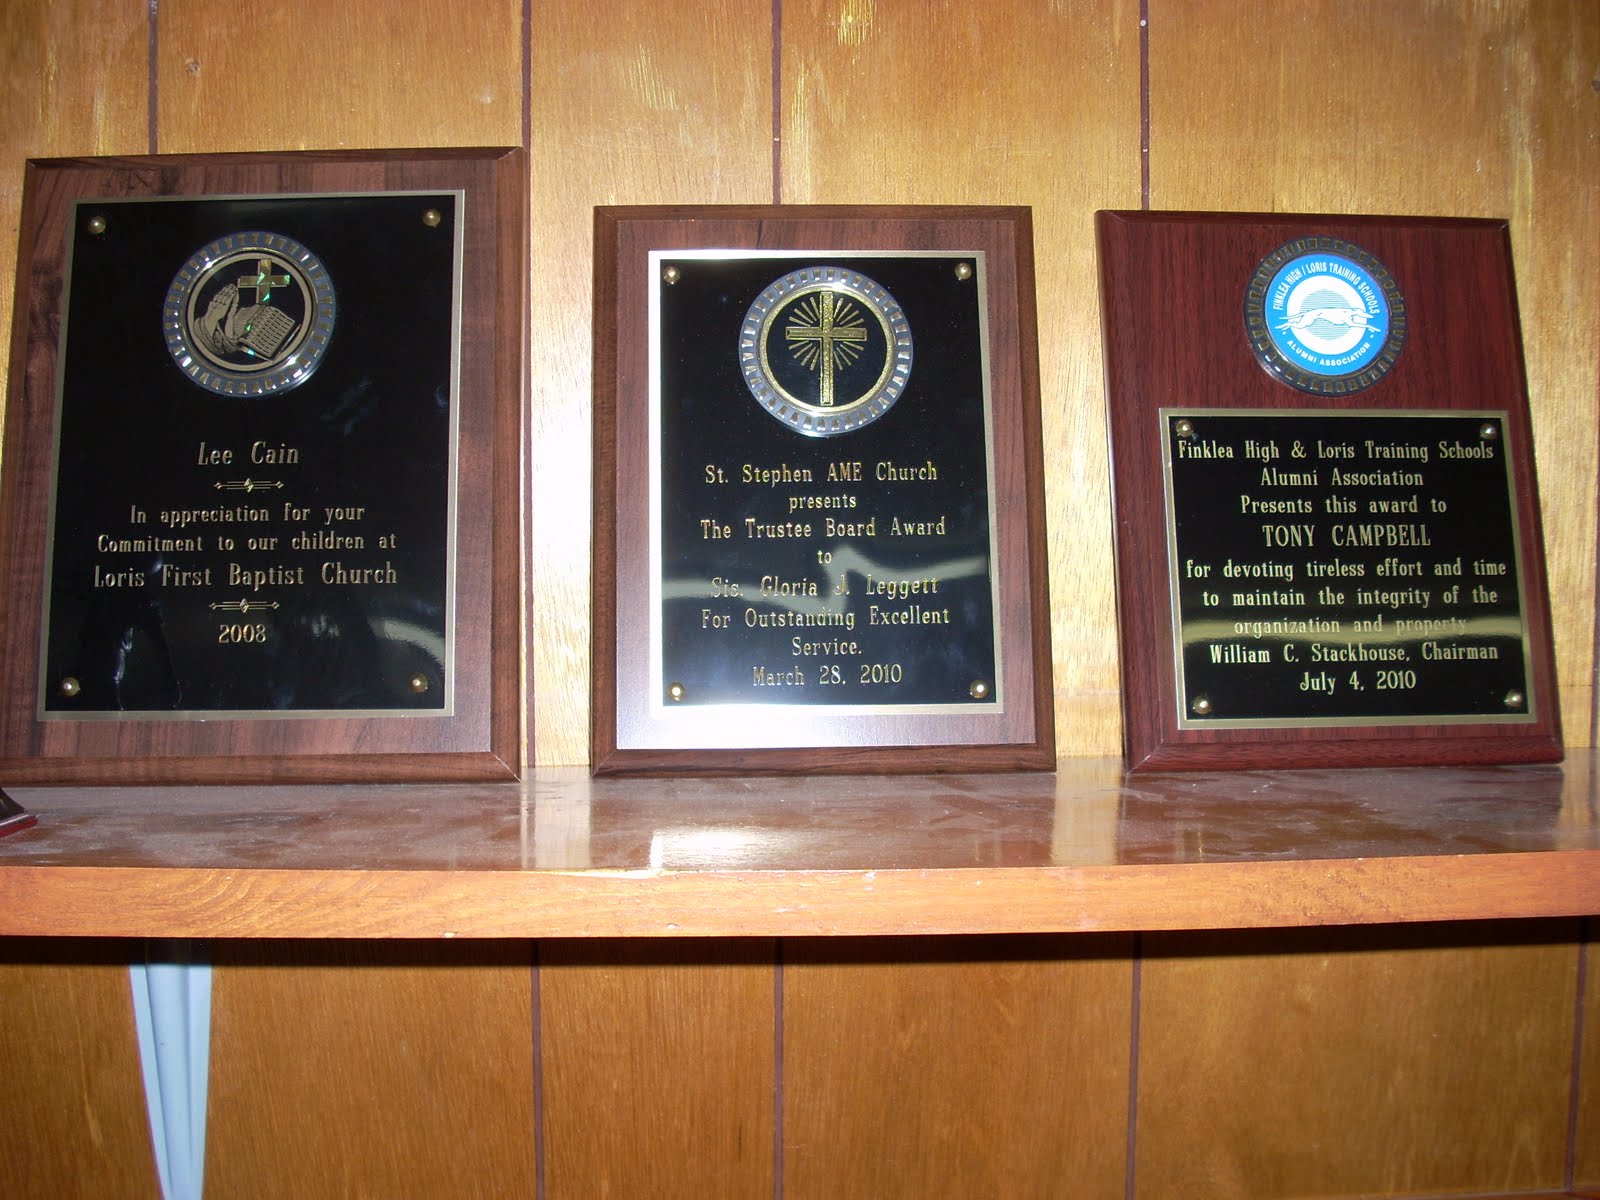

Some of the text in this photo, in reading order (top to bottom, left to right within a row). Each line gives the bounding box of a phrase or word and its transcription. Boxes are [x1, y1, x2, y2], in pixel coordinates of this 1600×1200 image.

[1273, 283, 1291, 310] FINKLEA
[1285, 268, 1303, 286] HIGH
[1306, 262, 1326, 274] LORIS
[1329, 263, 1360, 285] TRAINING
[1358, 282, 1380, 314] SCHOOLS
[1319, 342, 1371, 366] ASSOCIATION
[198, 441, 299, 465] Lee Cain
[1178, 441, 1494, 462] Finklea High & Loris Training Schools
[705, 462, 937, 487] St. Stephen AME Church
[1261, 468, 1424, 486] Alumni Association
[789, 494, 856, 513] presents
[1241, 496, 1446, 513] Presents this award to
[131, 503, 365, 527] In appreciation for your
[701, 517, 945, 538] The Trustee Board Award
[1263, 525, 1431, 547] TONY CAMPBELL
[98, 531, 396, 552] Commitment to our children at
[818, 551, 831, 564] to
[94, 562, 397, 591] Loris First Baptist Church
[1187, 559, 1506, 581] for devoting tireless effort and time
[761, 576, 817, 596] Gloria
[866, 575, 938, 600] Leggett
[1203, 586, 1498, 608] to maintain the integrity of the
[702, 606, 950, 630] For Outstanding Excellent
[1235, 619, 1340, 639] organization
[1354, 615, 1382, 632] and
[792, 637, 862, 655] Service.
[1210, 645, 1270, 663] William
[1284, 645, 1299, 663] C.
[1422, 642, 1498, 660] Chairman
[753, 666, 804, 686] March
[860, 664, 902, 683] 2010
[1300, 672, 1336, 695] July
[1377, 671, 1416, 689] 2010
